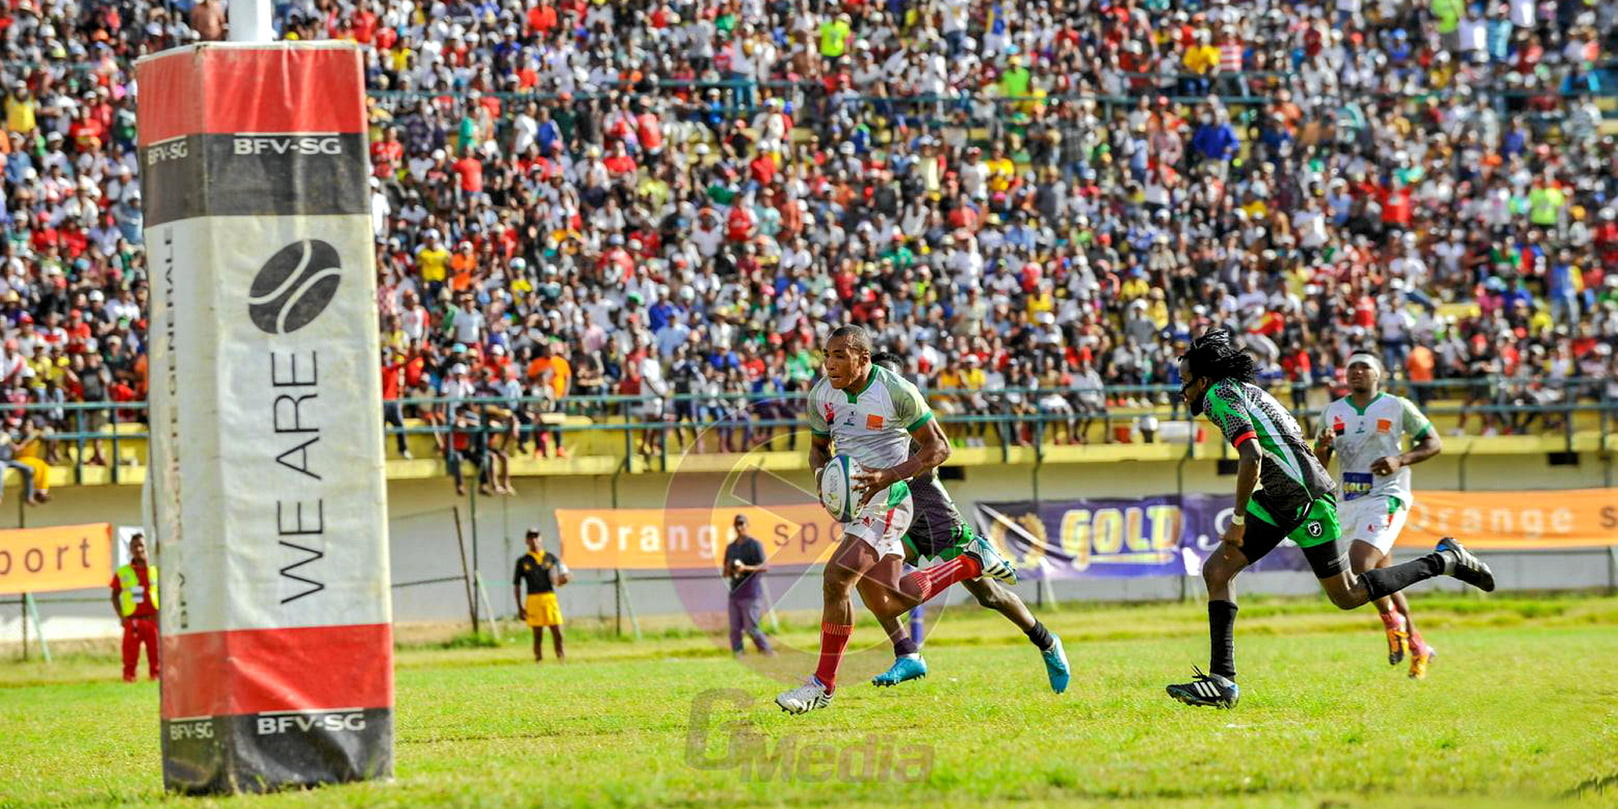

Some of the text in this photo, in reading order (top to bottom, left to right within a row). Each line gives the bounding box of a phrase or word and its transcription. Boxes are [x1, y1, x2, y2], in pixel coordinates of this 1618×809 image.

[148, 141, 188, 166] BFV-SG
[233, 137, 341, 155] BFV-SG
[271, 350, 325, 605] WE ARE
[1060, 504, 1185, 570] GOLD
[170, 722, 214, 740] BFV-SG
[257, 713, 366, 735] BFV-SG
